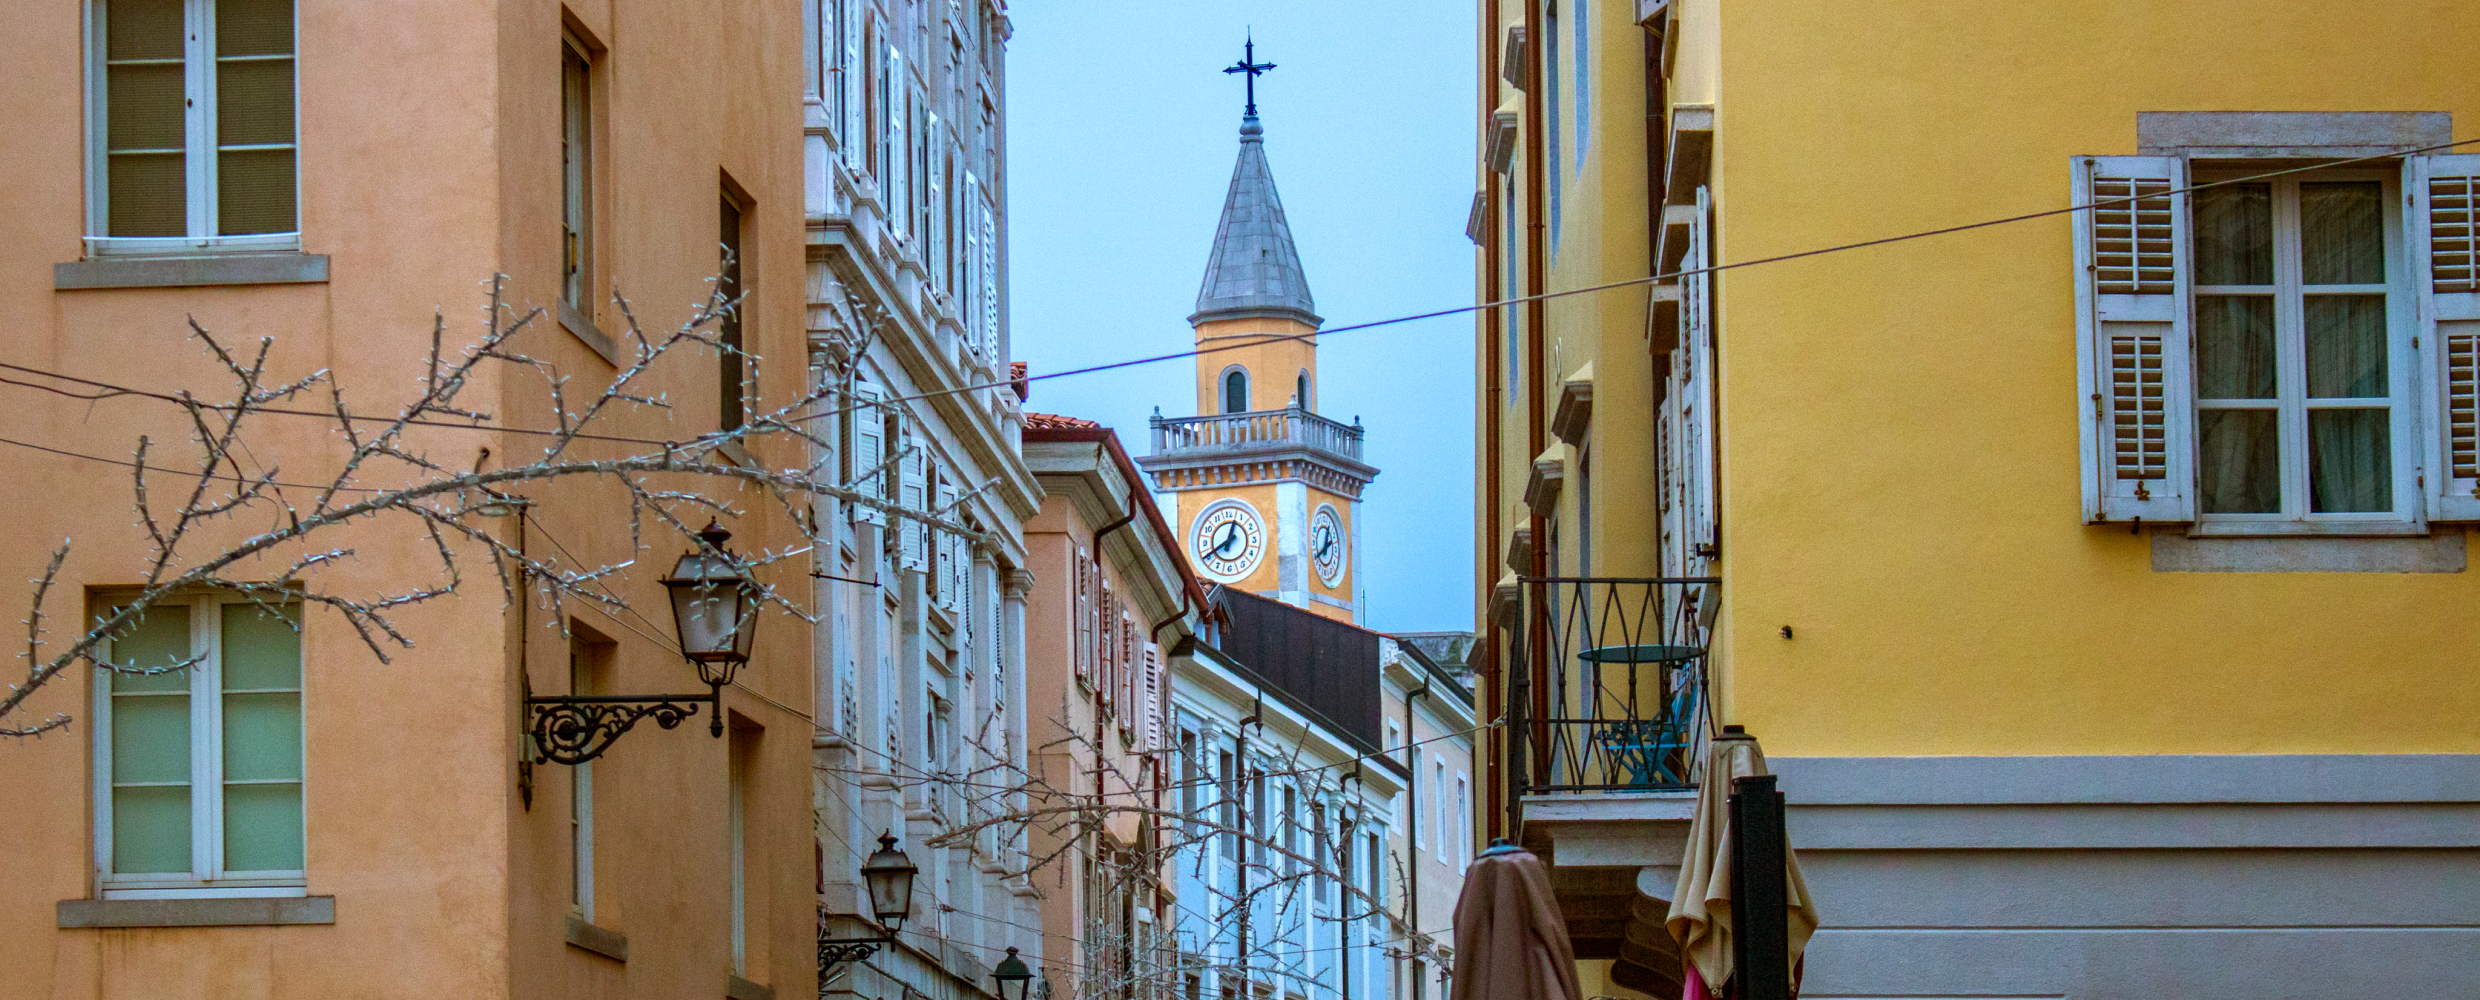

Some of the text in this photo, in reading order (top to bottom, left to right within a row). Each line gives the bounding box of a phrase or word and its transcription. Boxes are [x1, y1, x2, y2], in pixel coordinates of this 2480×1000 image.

[1214, 514, 1220, 523] 11
[1204, 525, 1213, 534] 10
[1248, 522, 1253, 530] 2
